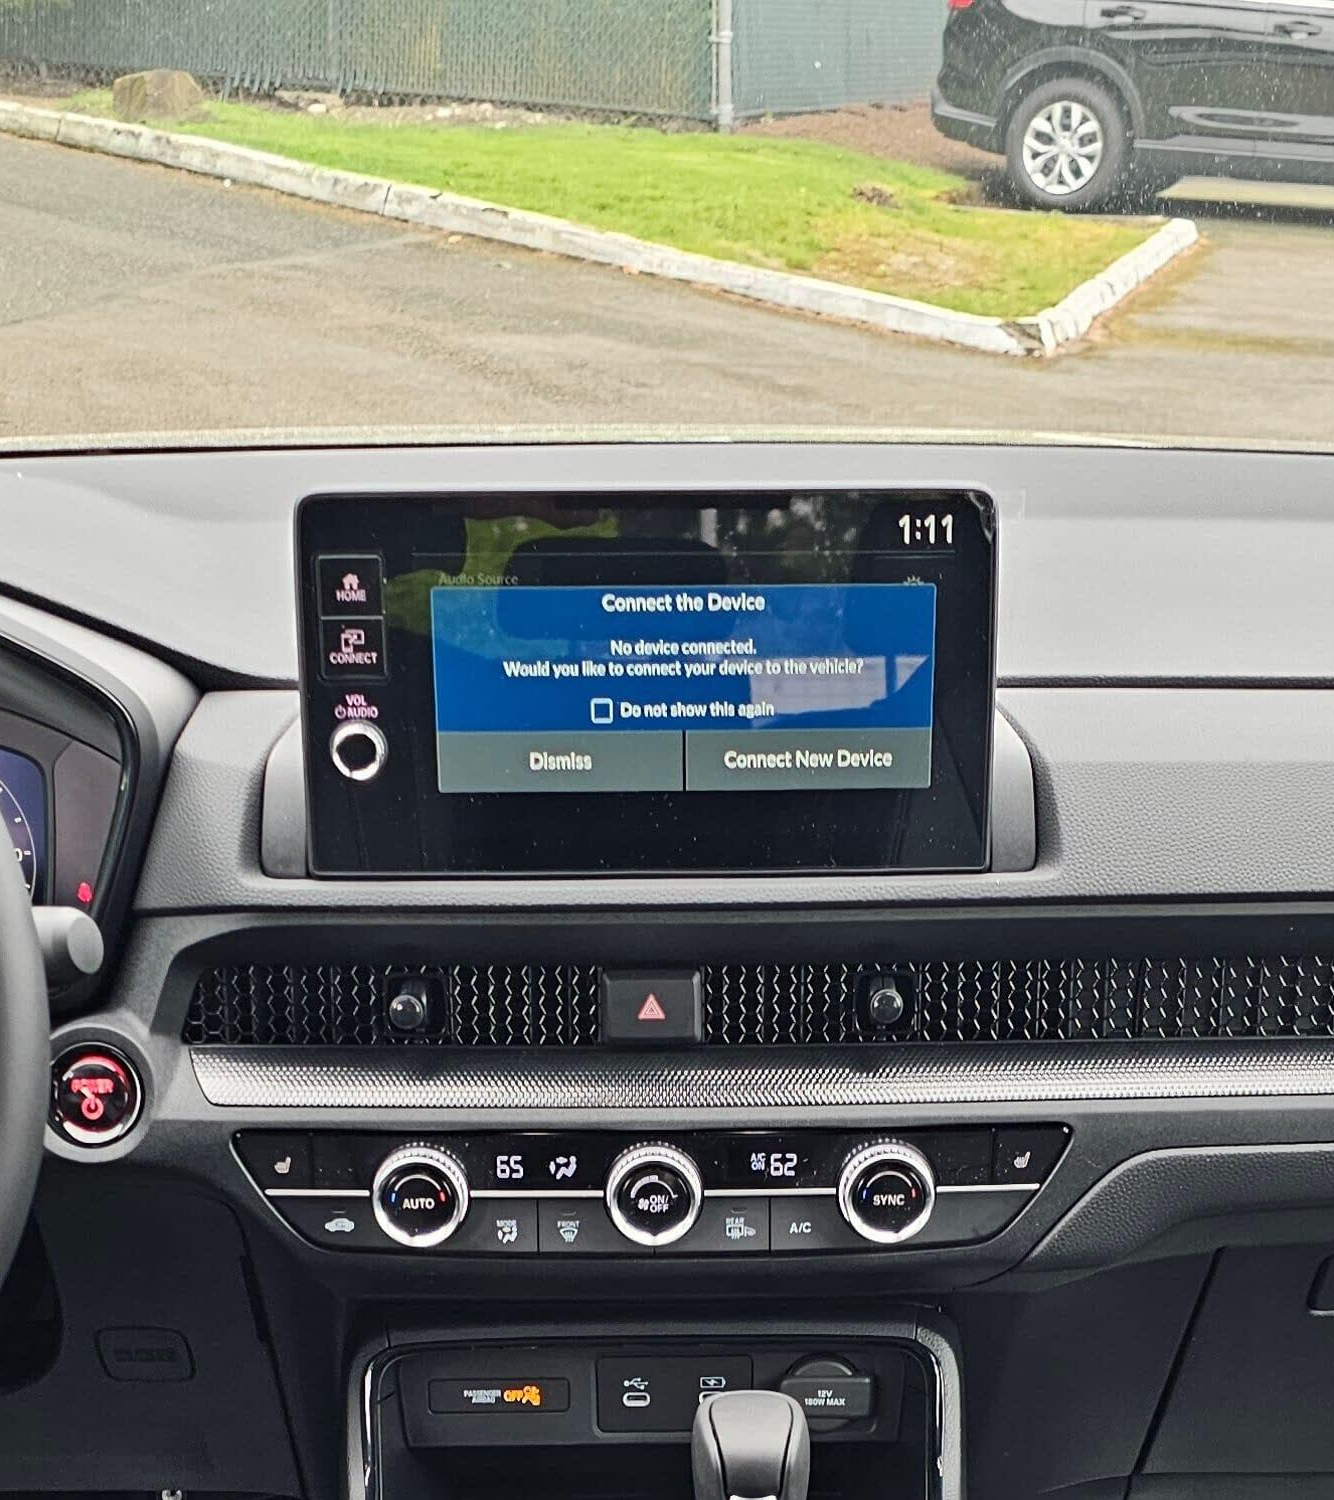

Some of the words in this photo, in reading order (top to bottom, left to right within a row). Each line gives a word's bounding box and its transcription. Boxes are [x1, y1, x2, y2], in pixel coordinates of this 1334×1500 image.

[898, 513, 954, 545] 1:11
[336, 589, 366, 602] HOME
[601, 594, 672, 612] Connect
[675, 594, 704, 611] the
[708, 593, 765, 611] Device
[609, 640, 631, 656] No
[634, 640, 676, 656] device
[679, 639, 757, 656] connected.
[329, 652, 379, 664] CONNECT
[503, 661, 548, 677] Would
[551, 666, 578, 681] you
[581, 660, 604, 676] like
[607, 661, 623, 676] to
[626, 661, 680, 676] connect
[684, 664, 715, 680] your
[719, 659, 760, 674] device
[764, 660, 780, 674] to
[783, 658, 806, 674] the
[809, 658, 865, 674] vehicle?
[346, 694, 367, 707] VOL
[347, 706, 379, 719] AUDIO
[620, 702, 641, 718] Do
[643, 703, 667, 718] not
[670, 702, 703, 718] show
[706, 701, 733, 717] this
[736, 702, 775, 721] again
[529, 754, 593, 771] Dismiss
[723, 751, 791, 769] Connect
[796, 750, 834, 768] New
[837, 749, 893, 768] Device
[495, 1155, 524, 1178] 65
[770, 1153, 798, 1177] 62
[402, 1198, 436, 1210] AUTO
[872, 1194, 905, 1206] SYNC
[649, 1203, 669, 1213] OFF
[789, 1222, 812, 1234] A/C
[826, 1397, 846, 1406] MAX
